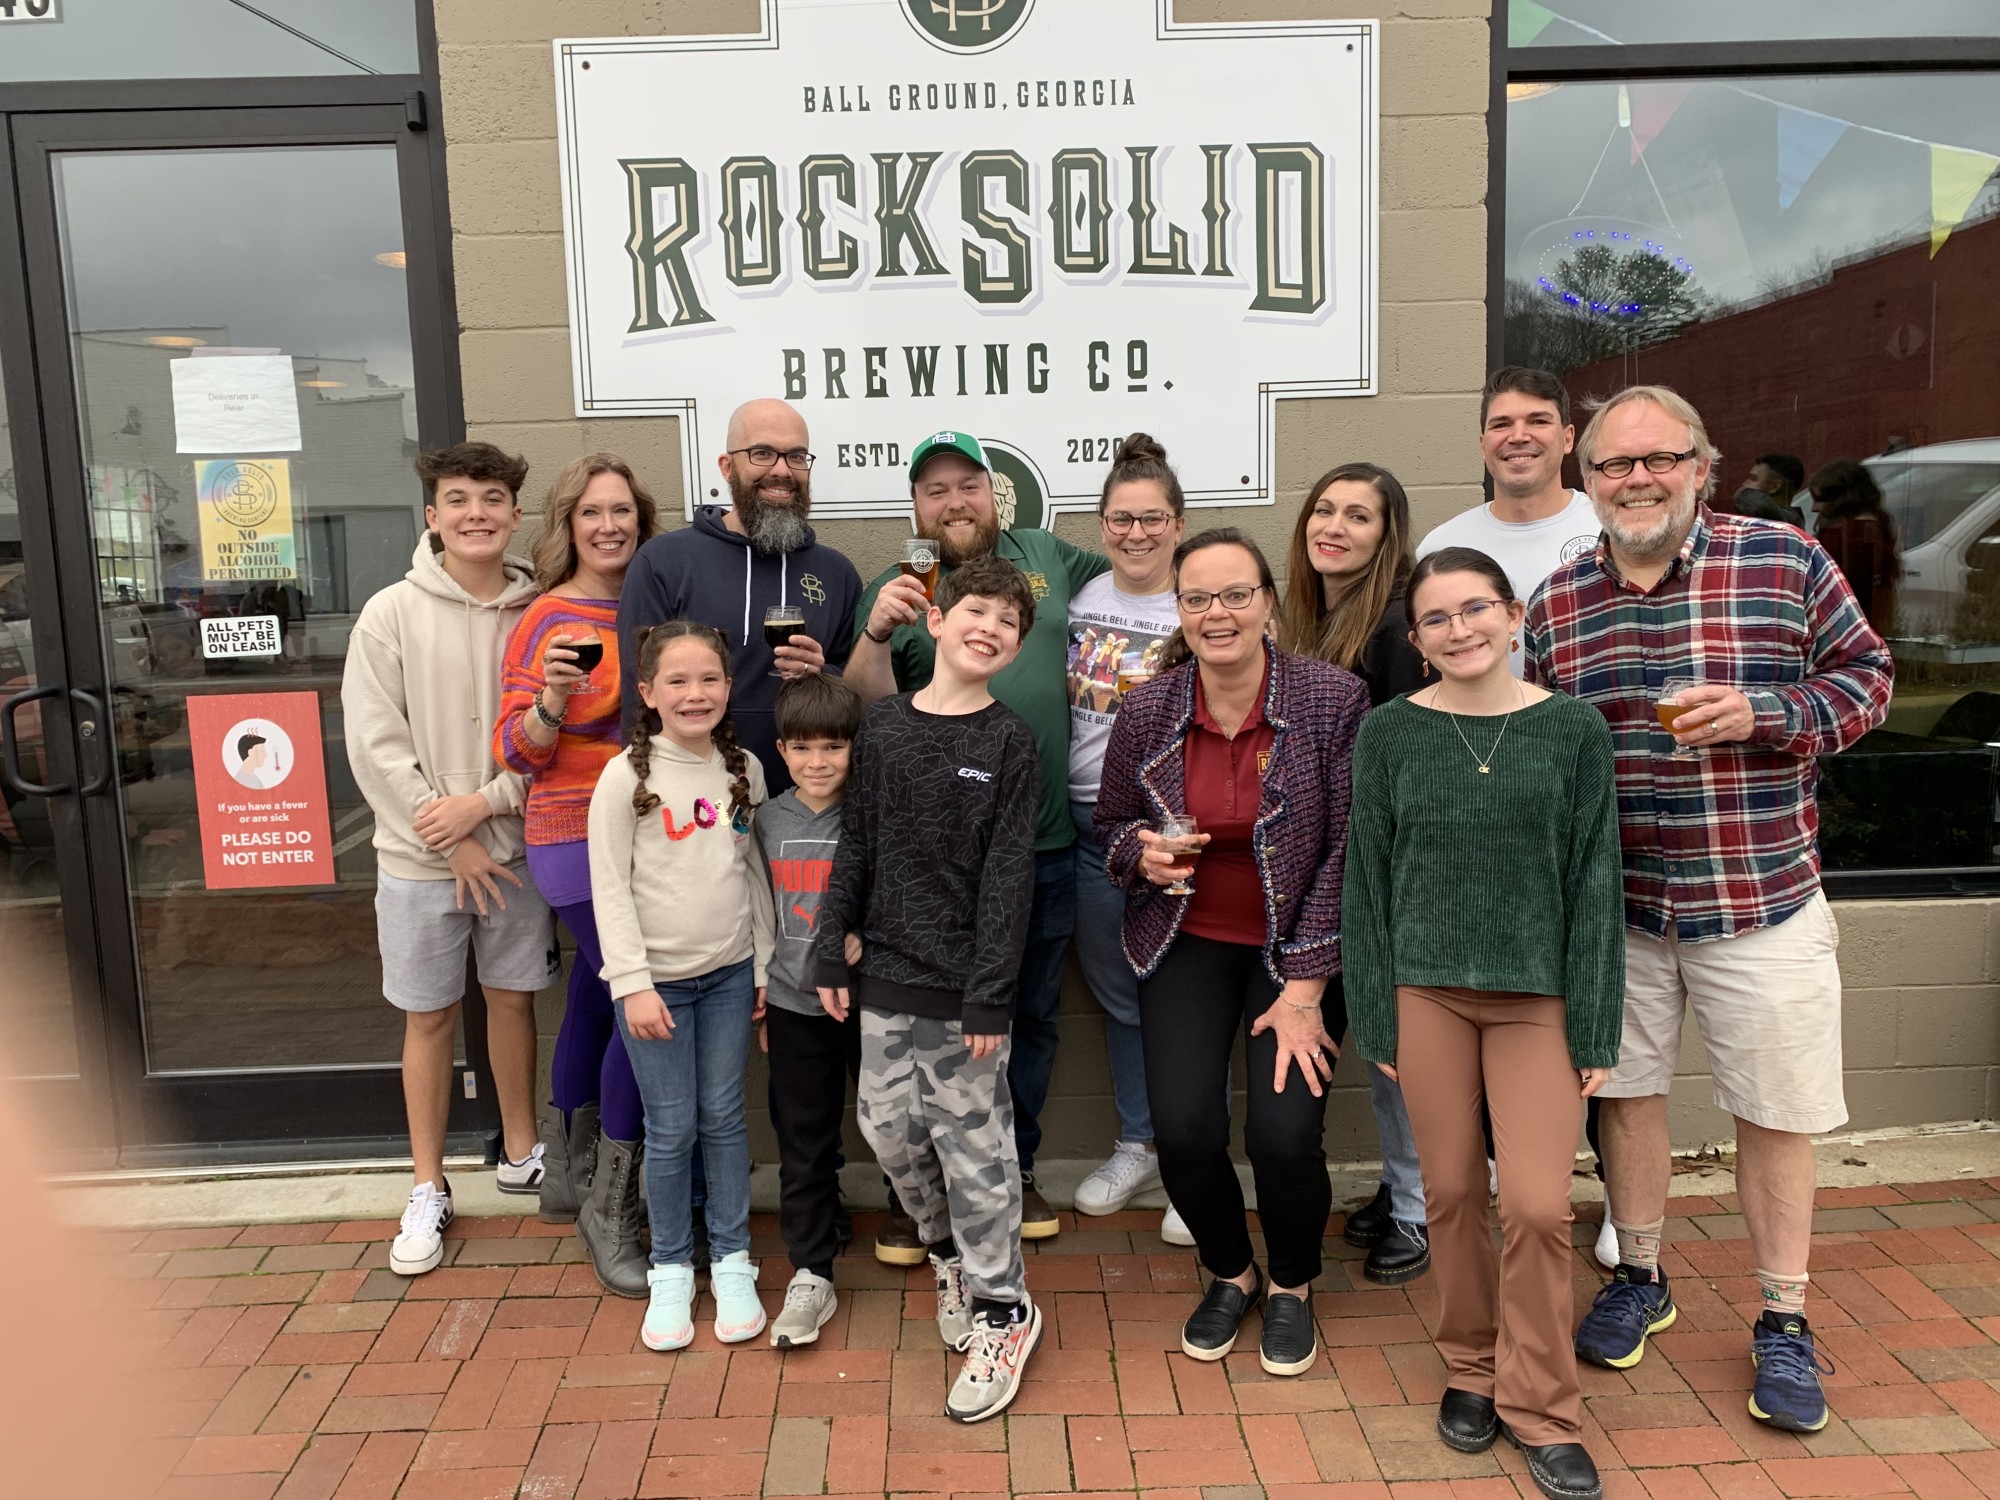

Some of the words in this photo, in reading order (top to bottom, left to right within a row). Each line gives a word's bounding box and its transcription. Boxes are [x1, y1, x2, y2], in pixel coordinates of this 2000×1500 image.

[803, 85, 871, 113] BALL
[889, 82, 1008, 111] GROUND,
[1017, 79, 1135, 108] GEORGIA
[781, 343, 1051, 400] BREWING
[208, 393, 249, 401] Deliveries
[224, 404, 244, 412] Rear
[837, 442, 908, 468] ESTD.
[238, 530, 257, 541] NO
[217, 542, 279, 554] OUTSIDE
[217, 555, 282, 567] ALCOHOL
[208, 567, 291, 580] PERMITTED
[207, 622, 233, 632] ALL
[238, 620, 274, 631] PETS
[1082, 612, 1106, 622] JINGLE
[1110, 615, 1128, 626] BELL
[1131, 620, 1160, 631] JINGLE
[208, 632, 249, 643] MUST
[256, 631, 275, 641] BE
[209, 643, 228, 653] ON
[233, 641, 276, 652] LEASH
[957, 767, 992, 782] EPIC
[218, 803, 226, 812] If
[227, 804, 246, 814] you
[248, 802, 272, 811] have
[281, 800, 308, 810] fever
[252, 815, 268, 823] are
[270, 813, 289, 822] sick
[221, 832, 282, 847] PLEASE
[285, 830, 312, 844] DO
[223, 852, 258, 866] NOT
[262, 850, 315, 864] ENTER
